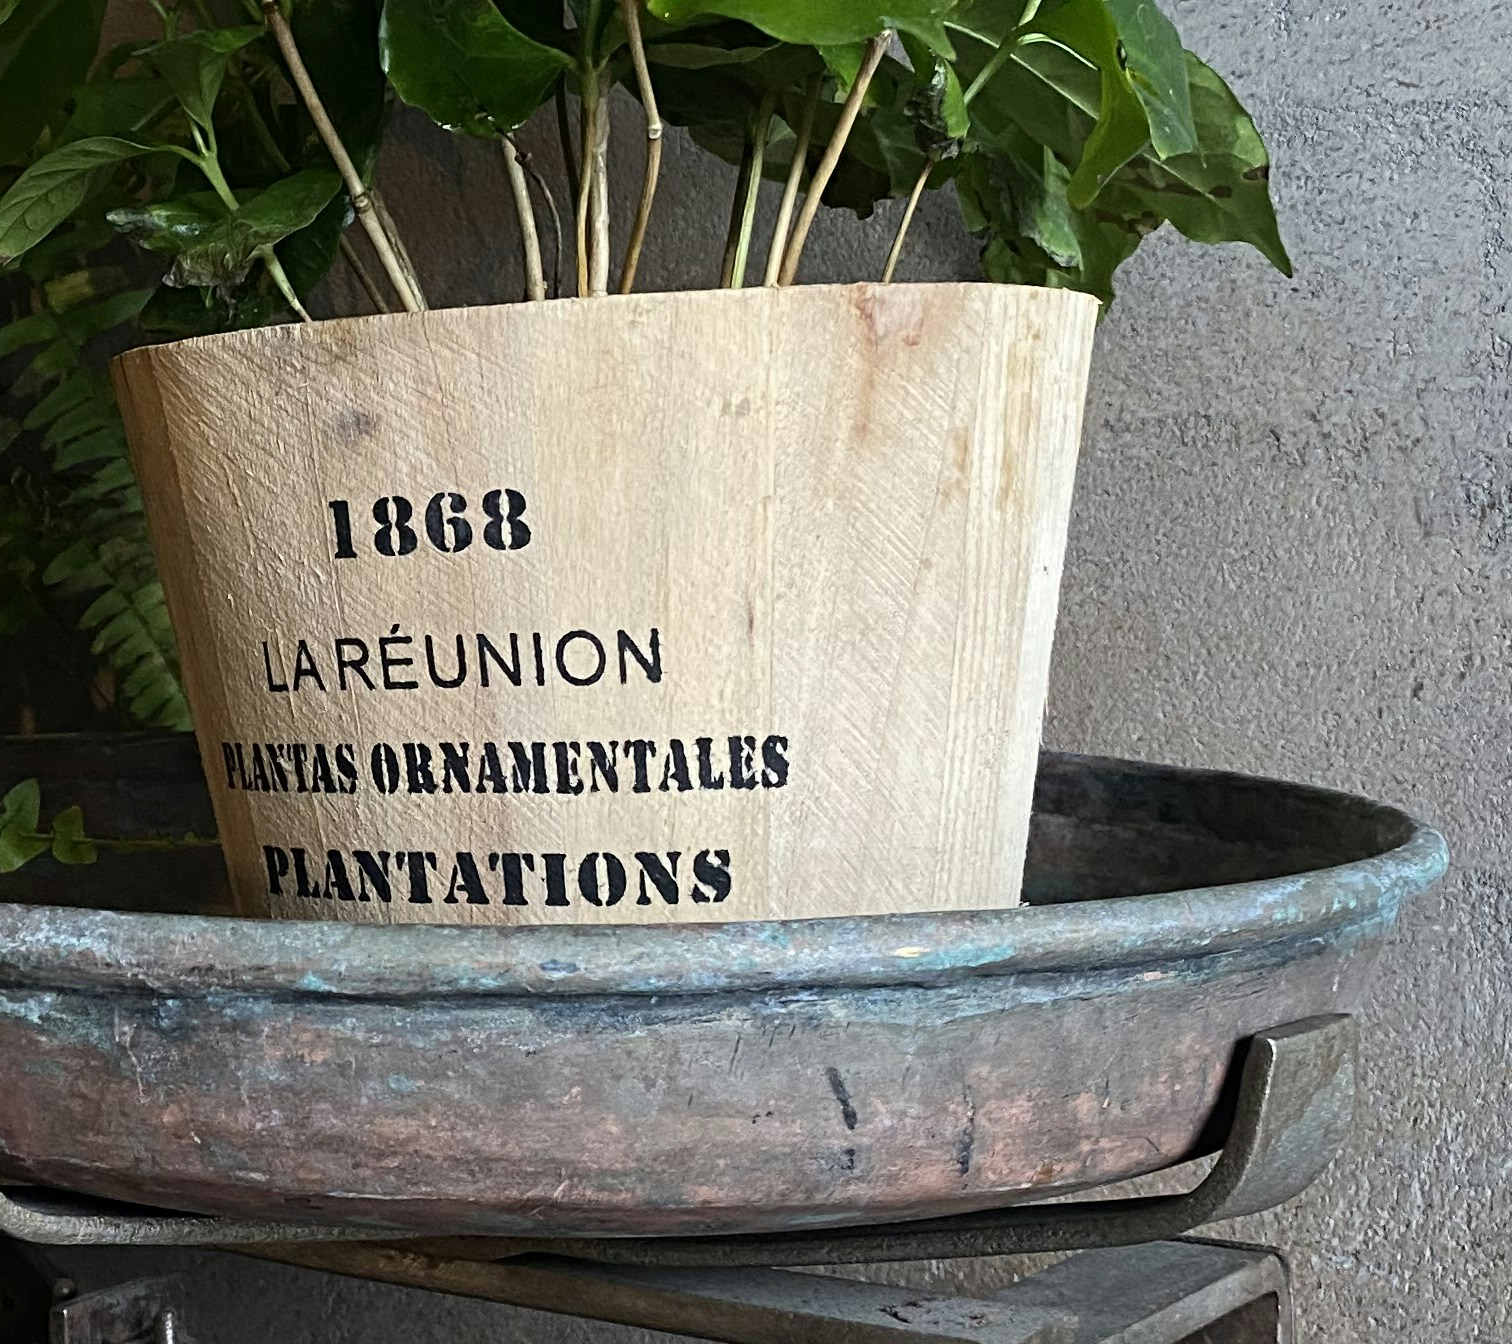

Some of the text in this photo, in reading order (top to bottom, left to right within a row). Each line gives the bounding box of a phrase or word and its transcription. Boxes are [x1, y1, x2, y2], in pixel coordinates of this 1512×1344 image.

[328, 488, 532, 560] 1868
[221, 734, 790, 797] PLANTAS ORNAMENTALES
[262, 844, 732, 908] PLANTATIONS
